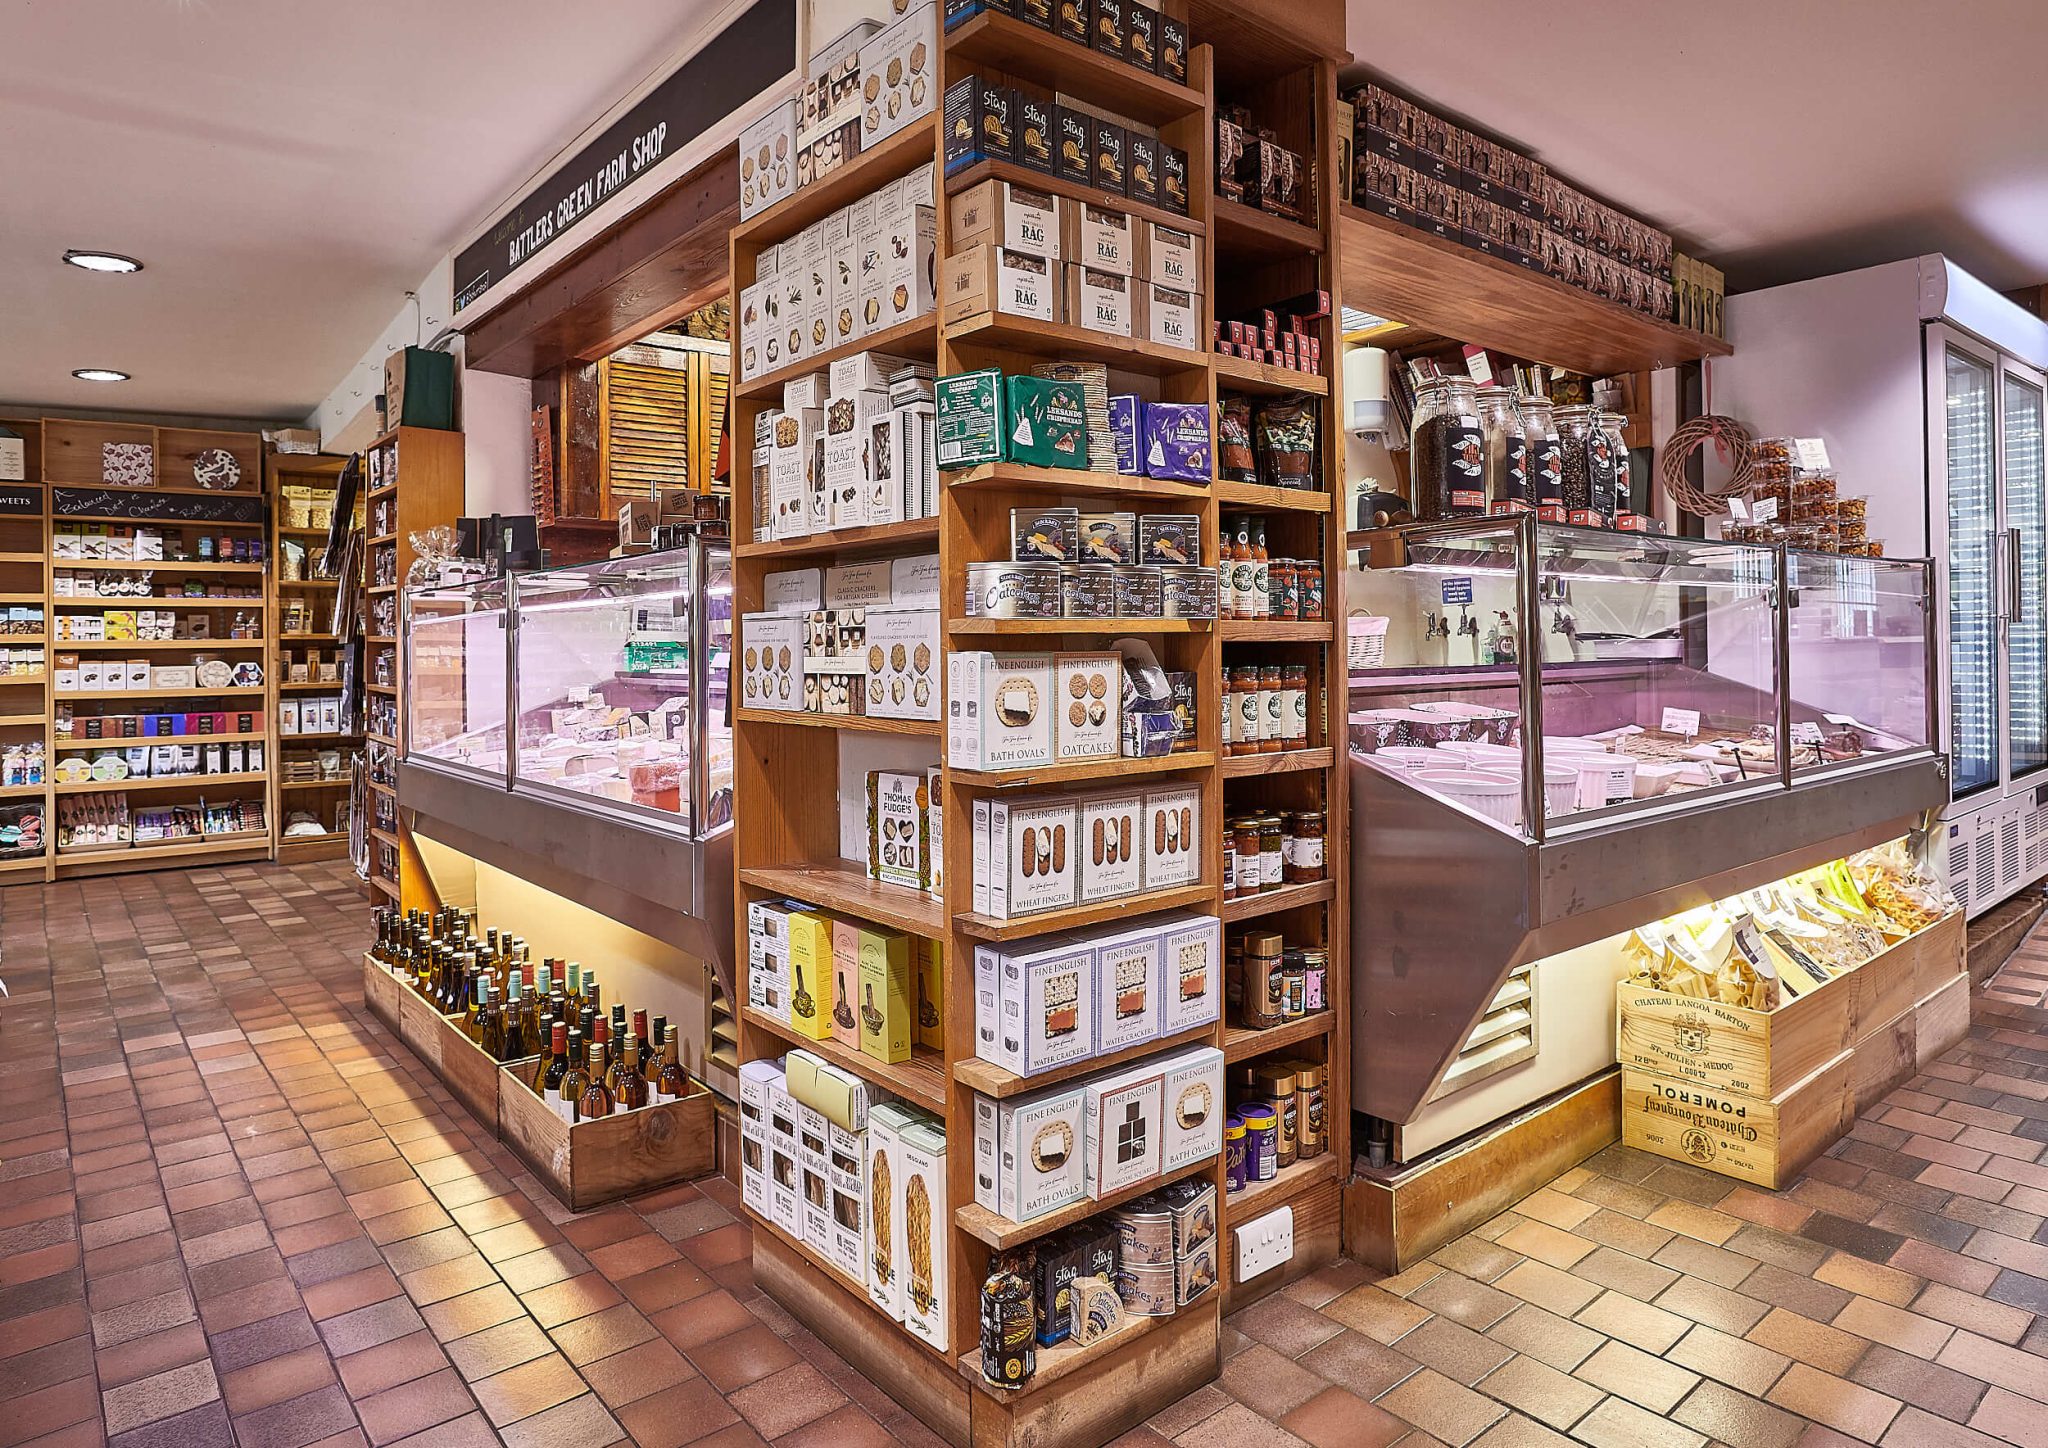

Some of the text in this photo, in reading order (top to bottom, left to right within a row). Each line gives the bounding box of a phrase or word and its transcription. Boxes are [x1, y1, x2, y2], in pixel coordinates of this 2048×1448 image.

[1100, 0, 1120, 25] stag
[1132, 10, 1151, 42] stag
[1165, 26, 1183, 56] stag
[984, 91, 1008, 124] stag
[1024, 104, 1047, 137] stag
[1063, 118, 1085, 148] stag
[1100, 131, 1120, 162] stag
[1134, 142, 1153, 172] stag
[1166, 155, 1184, 184] stag
[509, 121, 667, 266] BATTLERS GREEN FARM SHOP
[1021, 225, 1044, 242] RÅG
[1097, 242, 1118, 259] RÅG
[1164, 260, 1183, 277] RÅG
[1014, 288, 1038, 306] RÅG
[1096, 305, 1117, 322] RÅG
[1164, 321, 1182, 337] RÅG
[1047, 406, 1083, 418] LEKSANDS
[1047, 414, 1083, 425] CRISPBREAD
[1176, 428, 1209, 436] LEKSANDS
[1176, 434, 1209, 443] CRISPBREAD
[827, 447, 856, 464] TOAST
[776, 462, 801, 476] TOAST
[990, 660, 1045, 671] FINE ENGLISH
[1063, 659, 1113, 669] FINE ENGLISH
[1174, 681, 1193, 708] stag
[990, 749, 1046, 762] BATH OVALS
[1062, 742, 1113, 756] OATCAKES
[884, 793, 912, 804] THOMAS
[1088, 799, 1136, 812] FINE ENGLISH
[1151, 791, 1195, 804] FINE ENGLISH
[884, 803, 912, 814] FUDGE'S
[1017, 808, 1070, 822] FINE ENGLISH
[1150, 870, 1195, 884] WHEAT FINGERS
[1087, 881, 1135, 896] WHEAT FINGERS
[1016, 893, 1070, 909] WHEAT FINGERS
[1171, 929, 1214, 946] FINE ENGLISH
[1106, 942, 1155, 961] FINE ENGLISH
[1034, 957, 1087, 977] FINE ENGLISH
[1170, 1010, 1214, 1028] WATER CRACKERS
[1634, 998, 1751, 1032] CHATEAU LANGOA BARTON
[1105, 1028, 1154, 1047] WATER CRACKERS
[1034, 1046, 1087, 1068] WATER CRACKERS
[1173, 1063, 1217, 1084] FINE ENGLISH
[1731, 1079, 1750, 1090] 2002
[1109, 1084, 1157, 1107] FINE ENGLISH
[1652, 1083, 1746, 1118] POMEROL
[1026, 1099, 1079, 1123] FINE ENGLISH
[1643, 1096, 1757, 1142] Château Bourgneuf
[1170, 1141, 1216, 1164] BATH OVALS
[1106, 1174, 1134, 1189] CHARCOAL
[1026, 1185, 1079, 1212] BATH OVALS
[1121, 1236, 1149, 1254] cakes
[871, 1252, 896, 1281] LINGUE
[1092, 1249, 1113, 1273] stag
[907, 1284, 939, 1311] LINGUE
